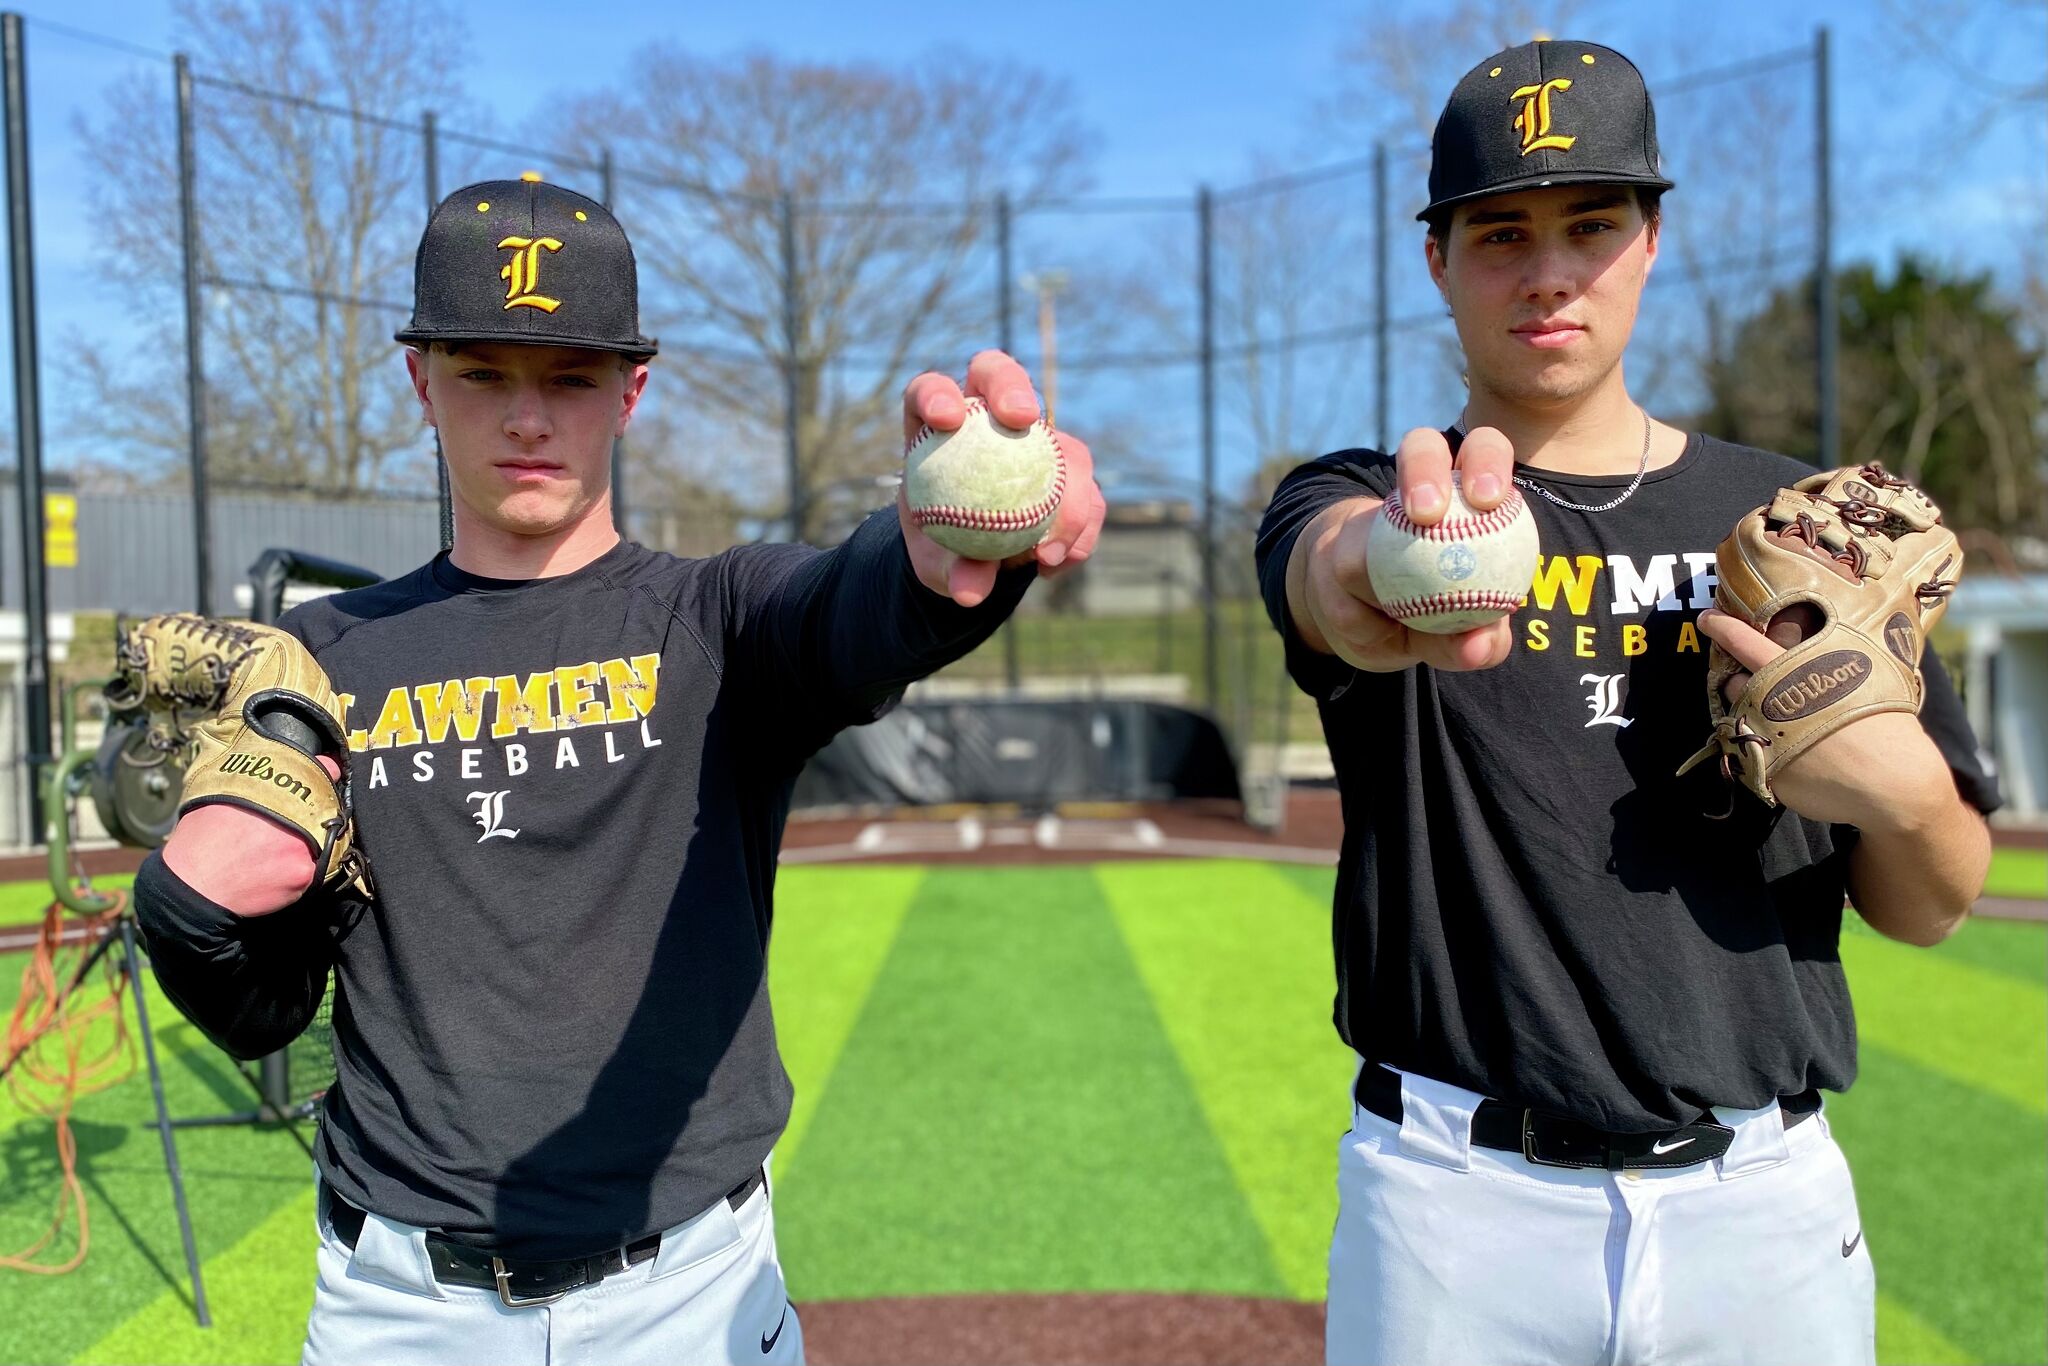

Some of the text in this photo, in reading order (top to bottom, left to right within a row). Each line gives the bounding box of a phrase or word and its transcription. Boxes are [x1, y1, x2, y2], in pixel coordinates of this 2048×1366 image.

[1526, 619, 1700, 657] SEBA
[1580, 673, 1635, 728] L
[1769, 660, 1865, 716] Wilson
[219, 753, 312, 803] Wilson
[368, 719, 662, 789] ASEBALL
[466, 790, 520, 843] L
